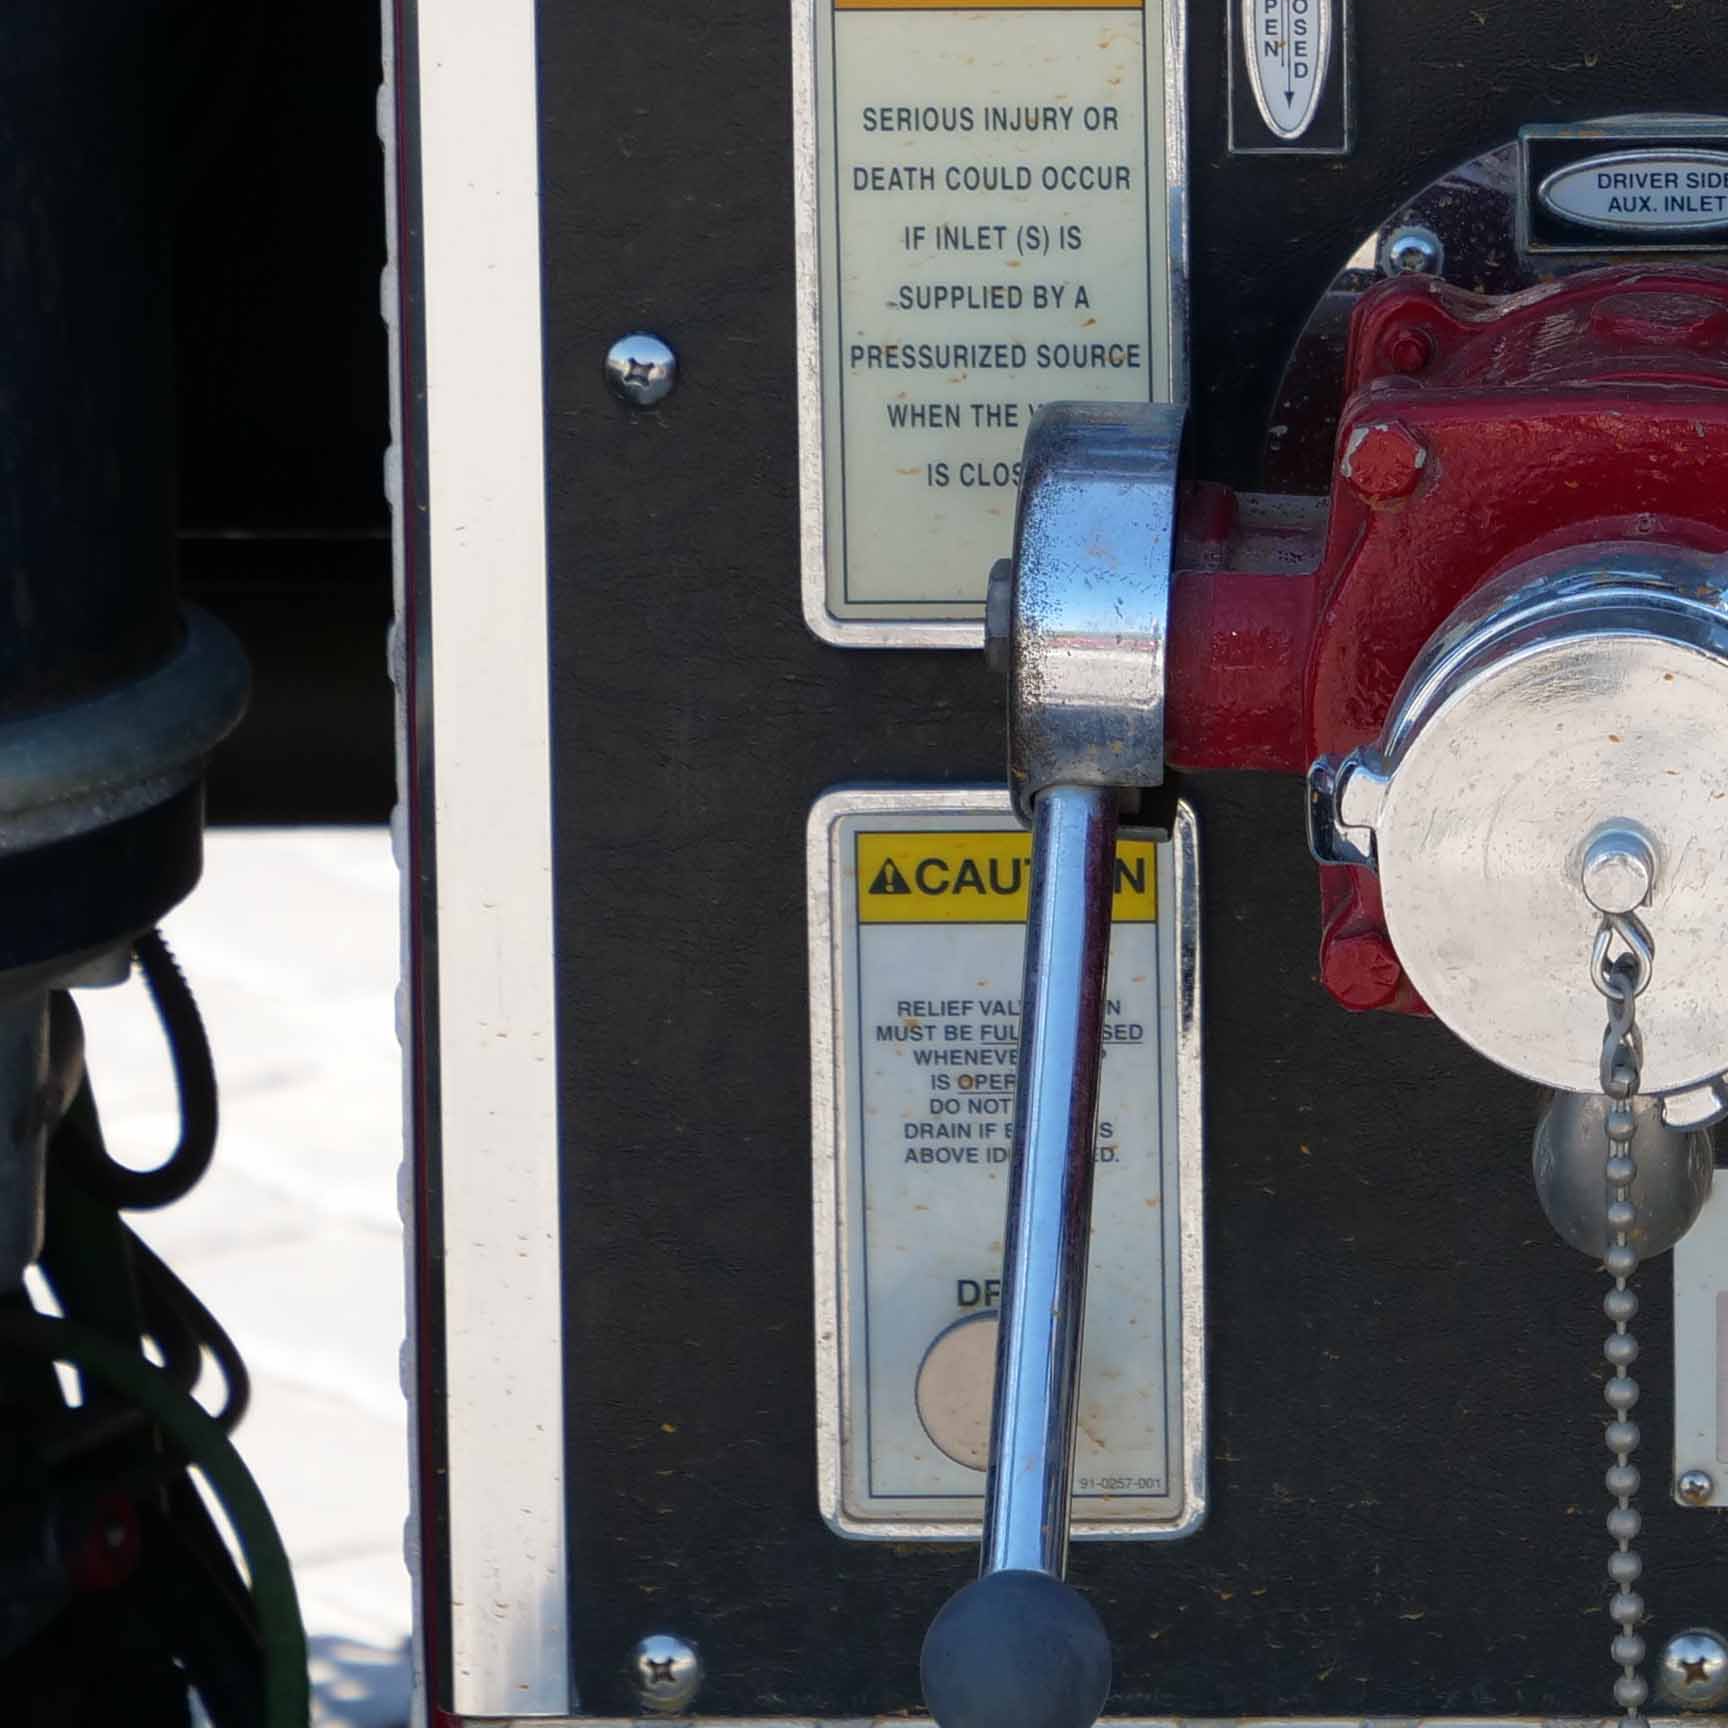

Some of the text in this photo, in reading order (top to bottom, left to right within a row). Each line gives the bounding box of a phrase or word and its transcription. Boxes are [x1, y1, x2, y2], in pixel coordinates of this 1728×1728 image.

[862, 106, 1119, 133] SERIOUS INJURY OR
[853, 165, 1131, 192] DEATH COULD OCCUR
[1597, 172, 1679, 190] DRIVER
[1608, 195, 1727, 213] AUX. INLET
[904, 224, 1082, 255] IF INLET (S) IS
[899, 285, 1090, 310] SUPPLIED BY A
[850, 344, 1141, 370] PRESSURIZED SOURCE
[887, 403, 961, 429] WHEN
[970, 403, 1019, 428] THE
[927, 463, 950, 488] IS
[914, 857, 1146, 895] CAUN
[897, 1000, 974, 1018] RELIEF
[876, 1025, 974, 1042] MUST BE
[913, 1049, 1018, 1066] WHENEVE
[930, 1074, 951, 1091] IS
[929, 1098, 1009, 1115] DO NOT
[903, 1123, 971, 1140] DRAIN
[979, 1123, 998, 1139] IF
[904, 1147, 979, 1164] ABOVE
[1079, 1477, 1161, 1489] 91-0257-001
